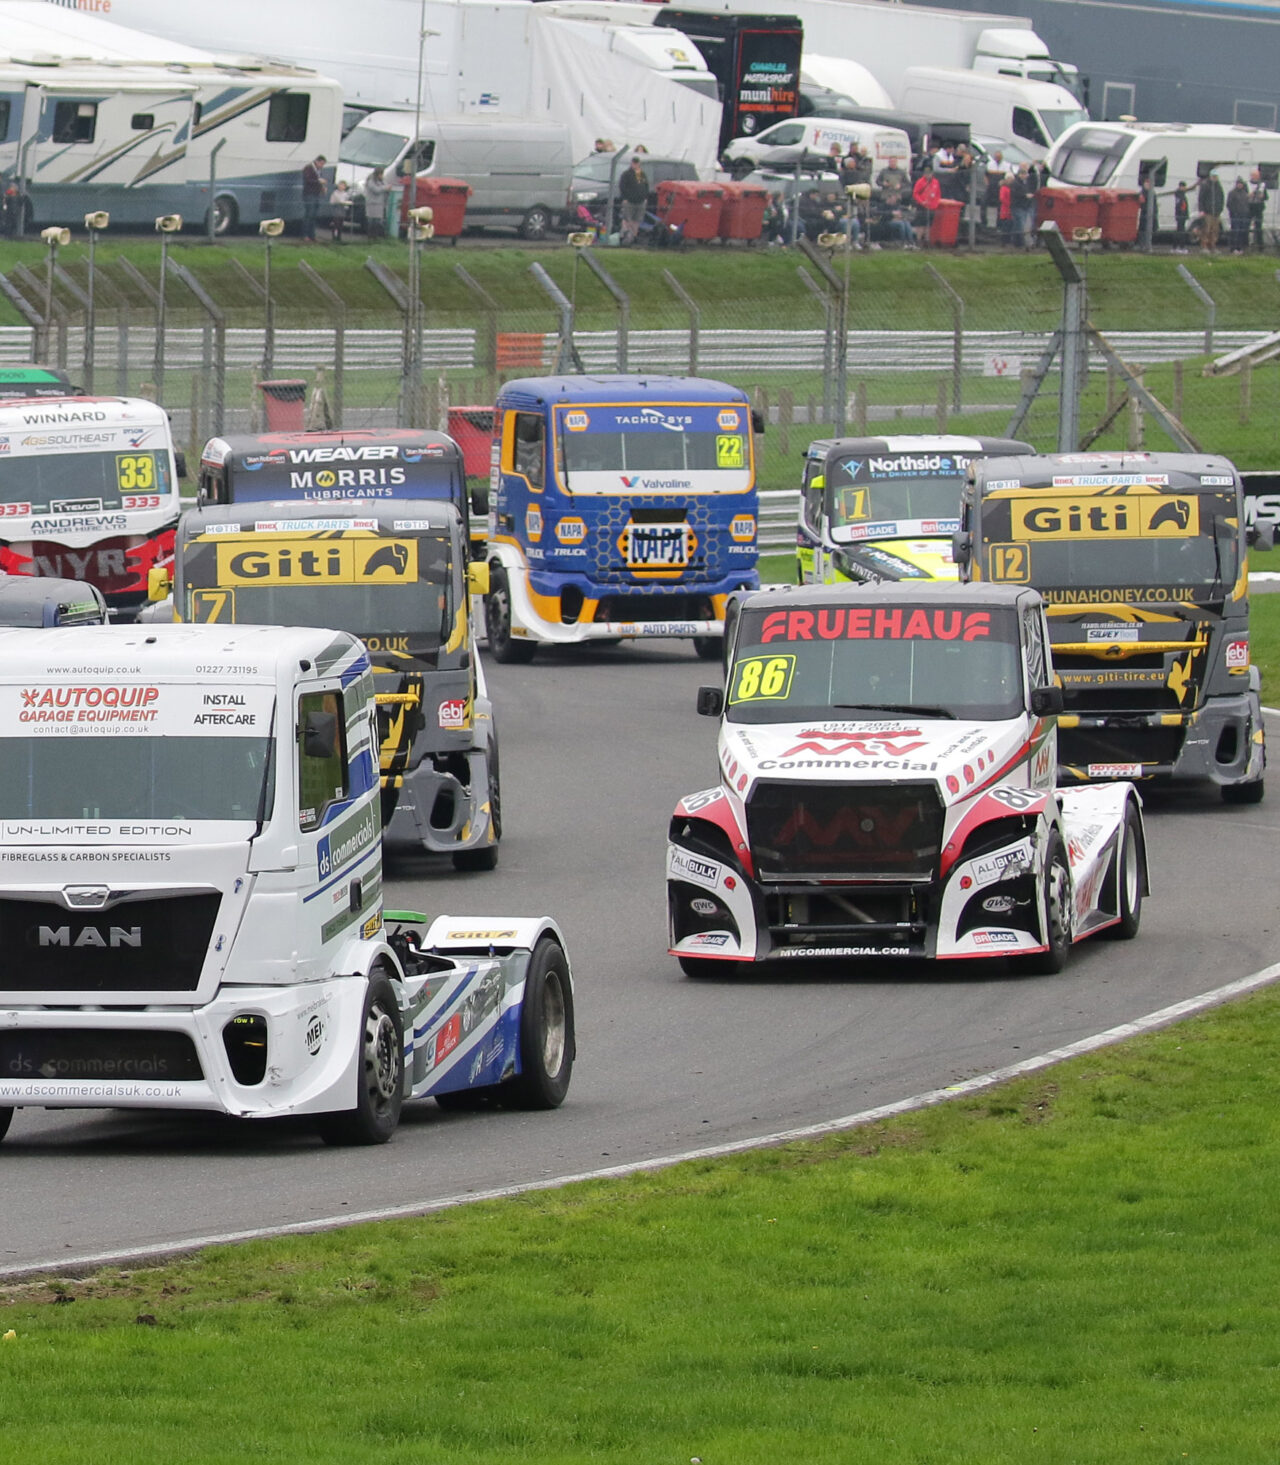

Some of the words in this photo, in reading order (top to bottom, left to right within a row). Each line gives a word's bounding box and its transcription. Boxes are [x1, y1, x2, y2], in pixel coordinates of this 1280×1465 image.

[740, 87, 794, 102] munihire
[24, 411, 106, 425] WINNARD
[569, 414, 586, 425] NAPA
[720, 414, 737, 425] NAPA
[719, 438, 740, 456] 22
[289, 446, 399, 464] WEAVER
[869, 455, 952, 472] Northside
[120, 457, 153, 489] 33
[290, 467, 406, 489] MORRIS
[642, 479, 691, 489] Valvoline
[1078, 477, 1109, 485] TRUCK
[1111, 476, 1142, 485] PARTS
[304, 488, 393, 500] LUBRICANTS
[124, 496, 161, 508] 333
[849, 490, 868, 519] 1
[30, 515, 127, 530] ANDREWS
[281, 520, 313, 530] TRUCK
[316, 520, 350, 529] PARTS
[1023, 504, 1127, 532] Giti
[32, 527, 72, 535] TIPPER
[105, 523, 127, 531] LTD
[560, 524, 582, 537] NAPA
[734, 521, 753, 535] NAPA
[851, 526, 895, 538] BRIGADE
[922, 522, 960, 532] BRIGAD
[633, 527, 683, 561] NAPA
[554, 548, 587, 556] TRUCK
[33, 549, 128, 578] NYR
[229, 549, 341, 578] Giti
[995, 548, 1024, 579] 12
[202, 592, 227, 624] 7
[643, 625, 667, 634] AUTO
[669, 624, 698, 633] PARTS
[761, 609, 991, 643] FRUEHAUF
[1225, 642, 1247, 660] febi
[46, 666, 141, 675] www.autoquip.co.uk
[195, 665, 224, 674] 01227
[226, 666, 258, 674] 731195
[737, 657, 788, 699] 86
[1063, 671, 1165, 684] www.giti-tire.eu
[38, 688, 159, 708] AUTOQUIP
[203, 694, 246, 706] INSTALL
[19, 710, 74, 723] GARAGE
[77, 710, 158, 722] EQUIPMENT
[438, 701, 464, 720] febi
[193, 714, 256, 725] AFTERCARE
[33, 725, 149, 735] contact@autoquip.co.uk
[757, 758, 938, 772] Commercial
[7, 825, 112, 835] UN-LIMITED
[120, 826, 192, 836] EDITION
[320, 850, 331, 875] ds
[332, 816, 374, 866] commercials
[1, 852, 59, 862] FIBREGLASS
[60, 852, 68, 861] &
[69, 852, 110, 862] CARBON
[111, 851, 171, 862] SPECIALISTS
[674, 856, 717, 880] ALIBULK
[38, 925, 142, 947] MAN
[451, 931, 491, 939] Giti
[974, 932, 1017, 943] BRIGADE
[780, 946, 910, 957] MVCOMMERCIAL.COM
[307, 1020, 322, 1047] MEI
[9, 1054, 33, 1073] ds
[48, 1055, 168, 1073] commercials
